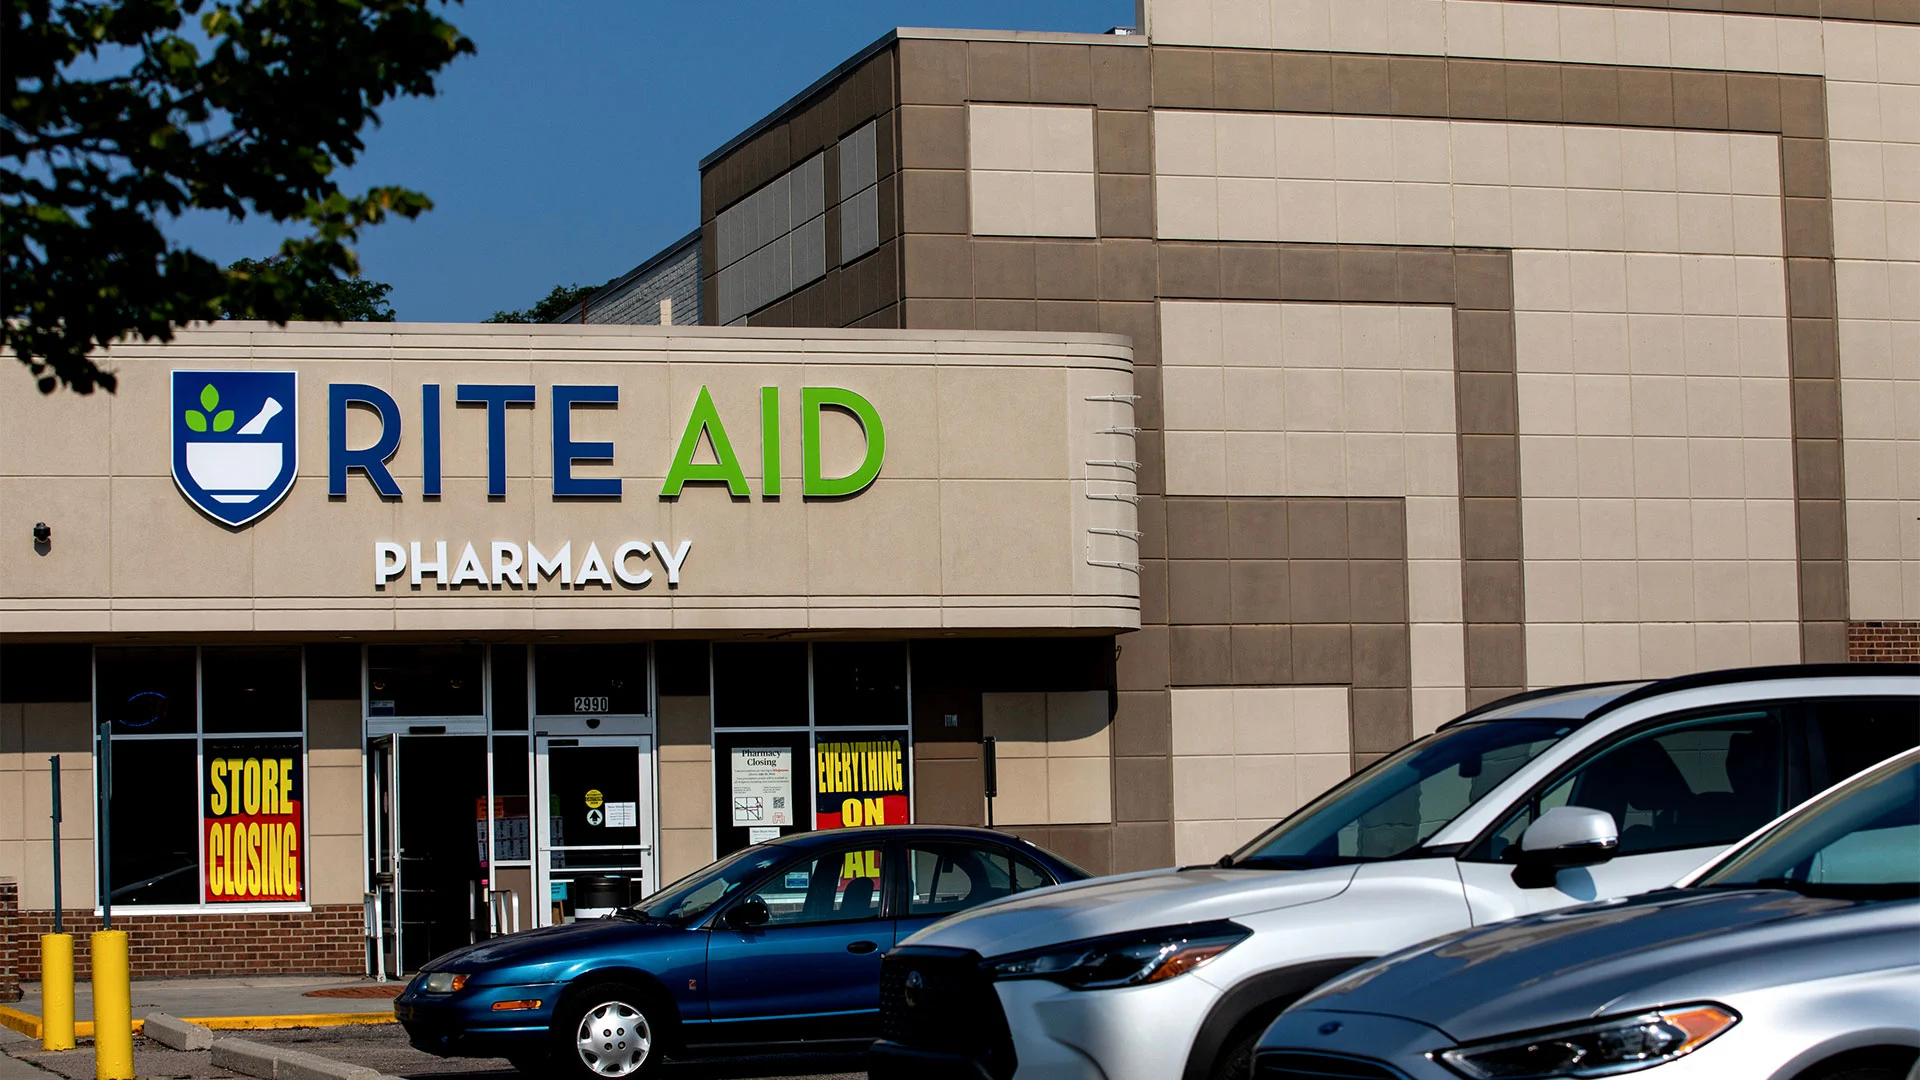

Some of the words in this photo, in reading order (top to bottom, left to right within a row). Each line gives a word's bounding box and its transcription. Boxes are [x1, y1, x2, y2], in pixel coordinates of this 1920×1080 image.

[328, 383, 623, 498] RITE
[659, 384, 886, 498] AID
[375, 540, 692, 587] PHARMACY
[575, 697, 608, 712] 2990
[742, 749, 782, 758] Pharmacy
[747, 758, 777, 767] Closing
[817, 740, 903, 793] EVERYTHING
[210, 757, 294, 816] STORE
[842, 797, 885, 827] ON
[209, 822, 298, 897] CLOSING
[839, 850, 882, 879] AL
